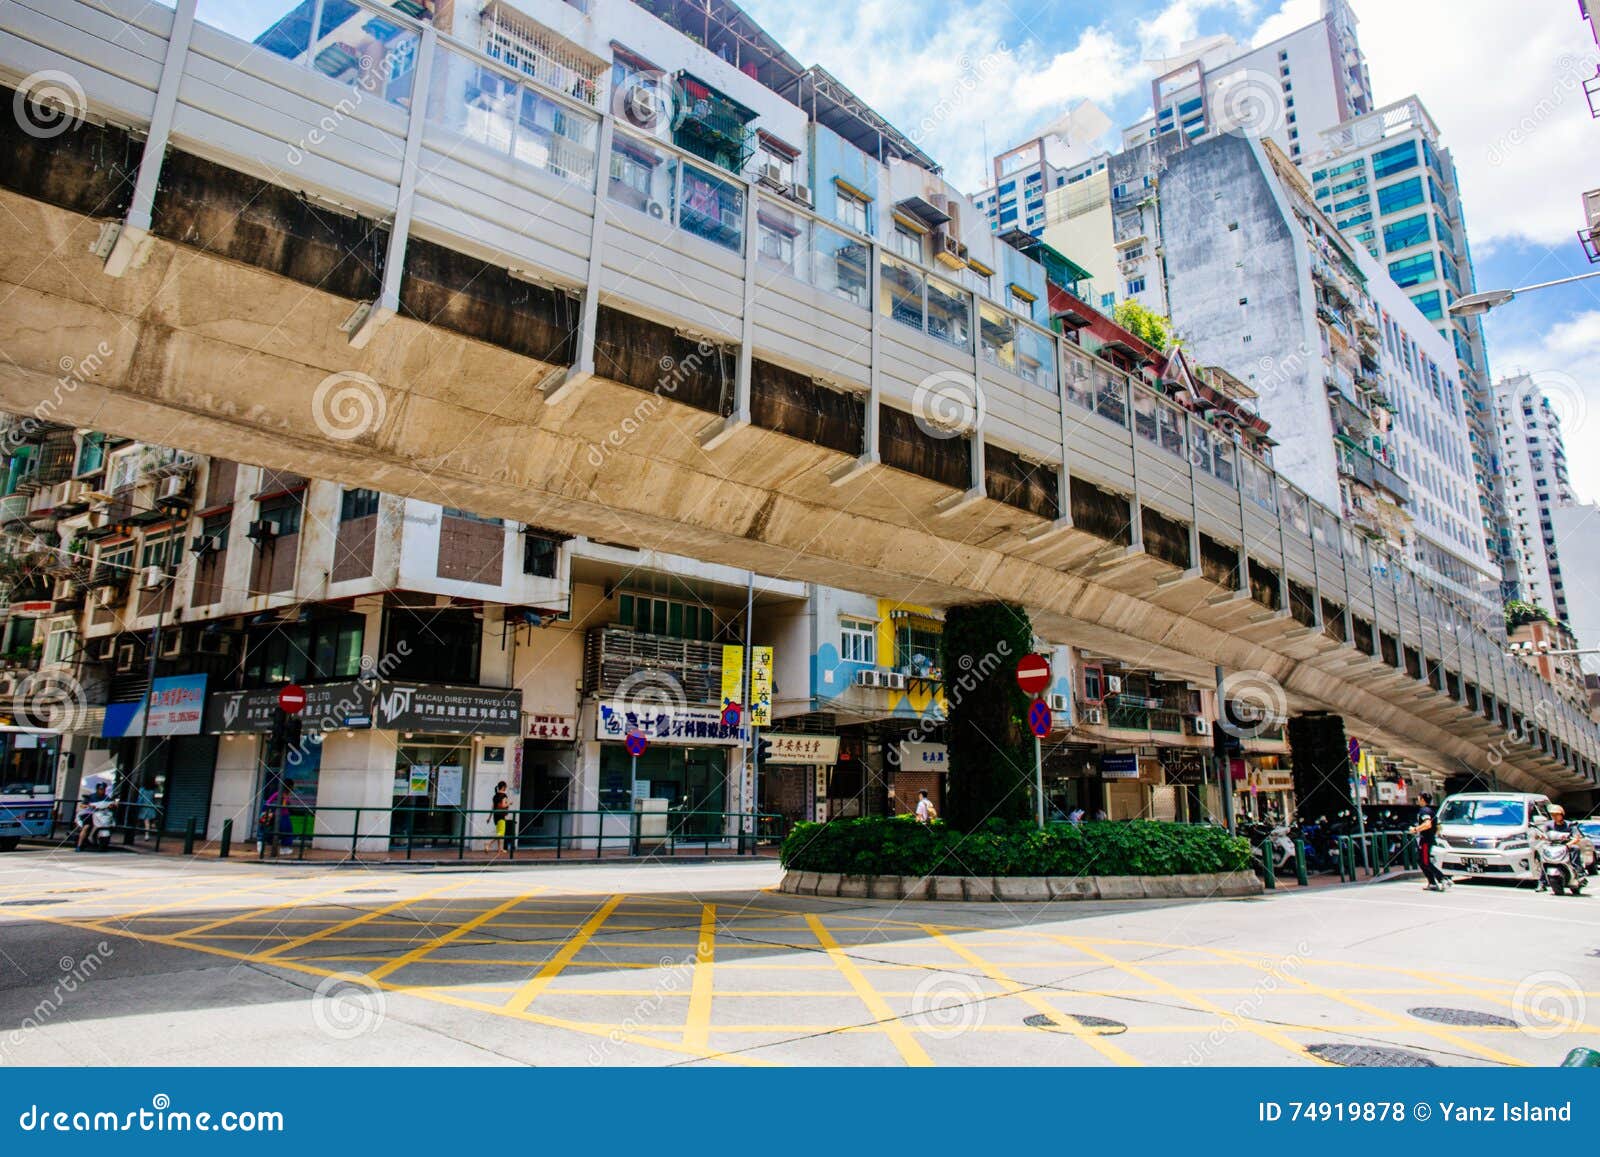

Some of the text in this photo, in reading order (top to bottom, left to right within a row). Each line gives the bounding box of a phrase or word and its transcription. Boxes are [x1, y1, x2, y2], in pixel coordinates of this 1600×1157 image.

[380, 687, 417, 723] MDT
[415, 693, 443, 703] MACAU
[444, 695, 473, 705] DIRECT
[474, 697, 502, 707] TRAVEL
